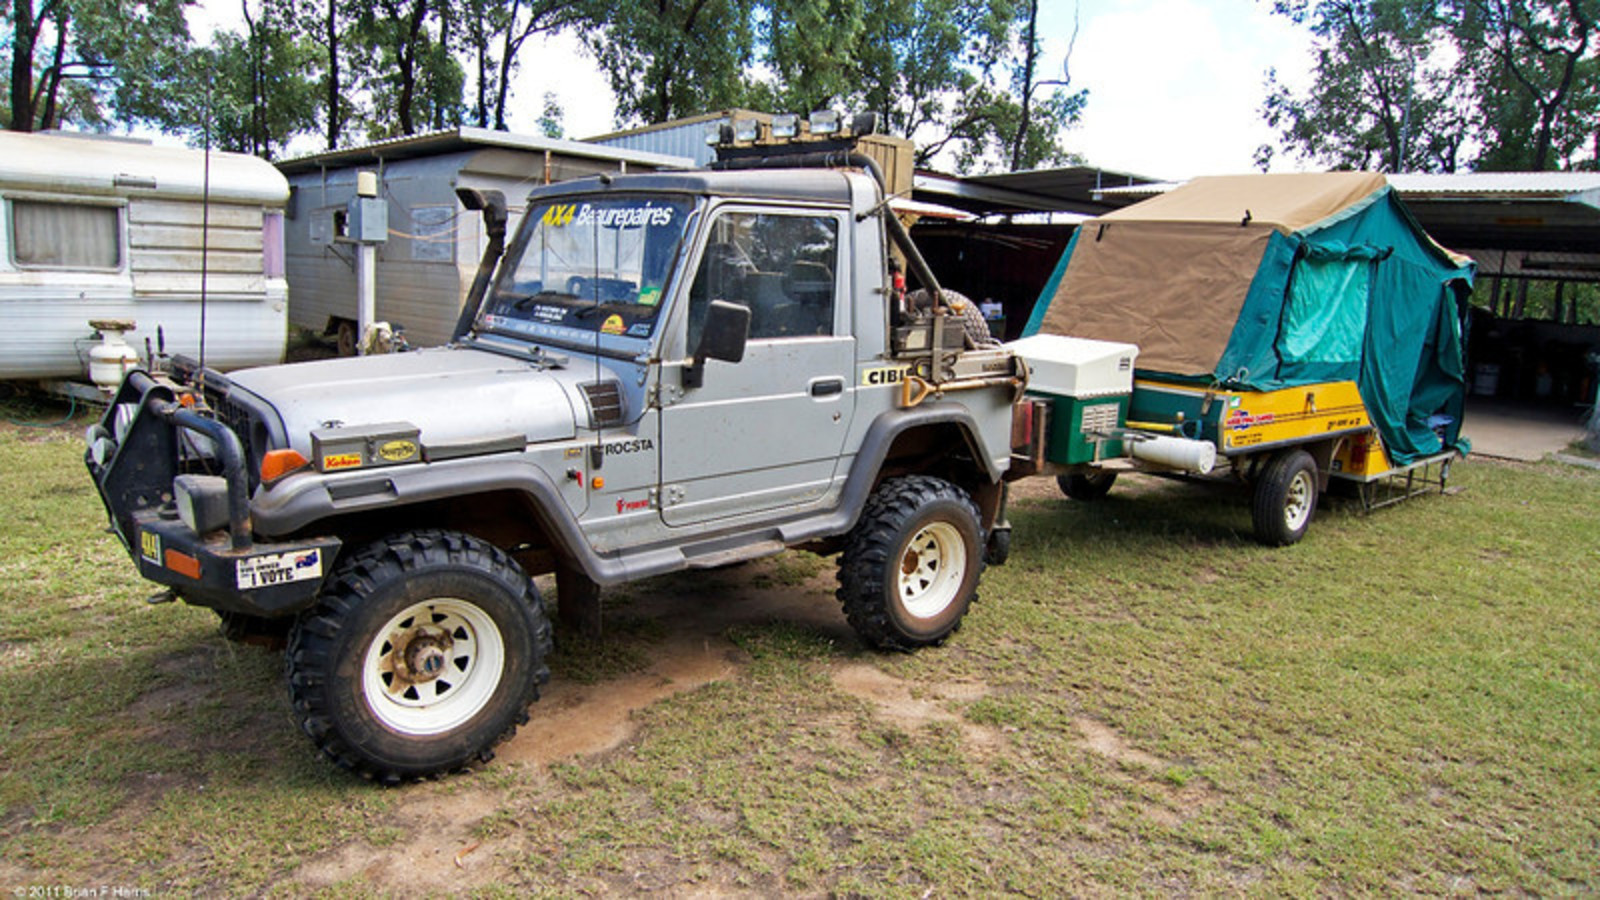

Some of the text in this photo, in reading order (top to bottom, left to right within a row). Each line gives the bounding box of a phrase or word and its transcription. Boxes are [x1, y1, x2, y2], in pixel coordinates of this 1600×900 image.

[576, 201, 673, 230] Beaurepaires
[868, 369, 909, 384] CIBI
[605, 439, 654, 455] ROCSTA
[260, 566, 295, 584] VOTE
